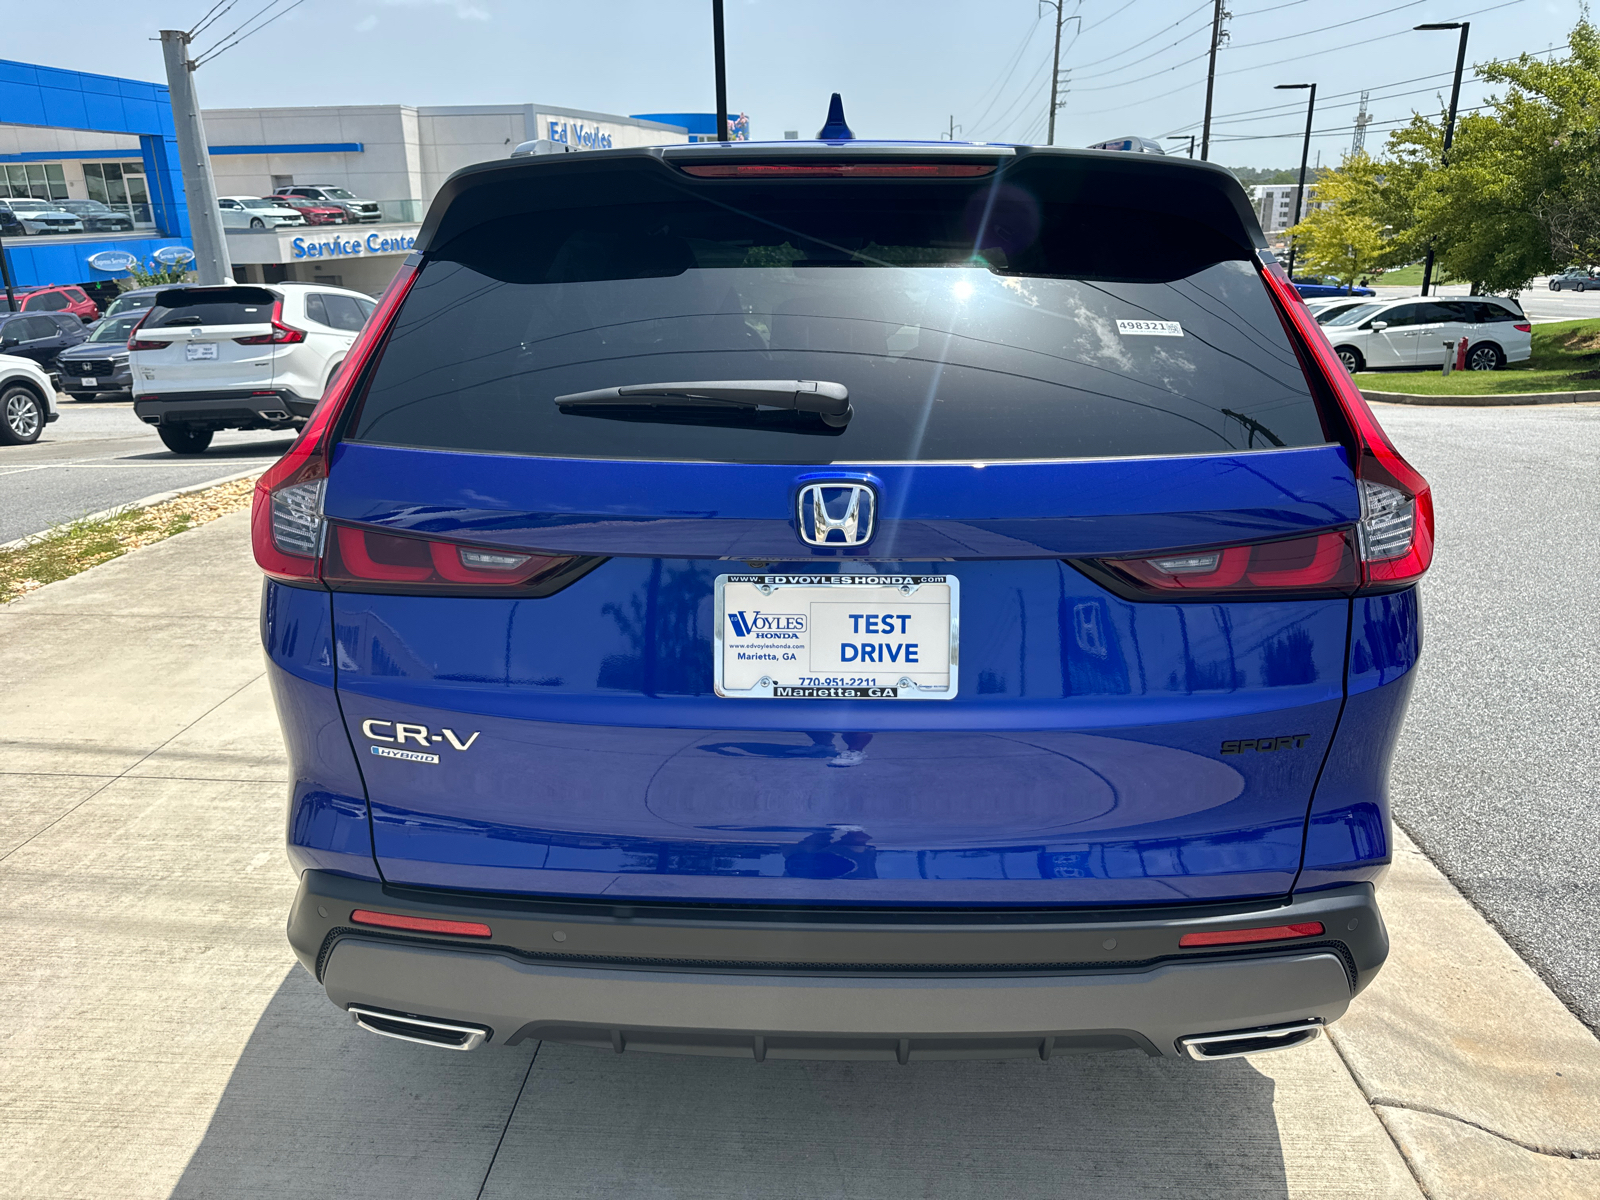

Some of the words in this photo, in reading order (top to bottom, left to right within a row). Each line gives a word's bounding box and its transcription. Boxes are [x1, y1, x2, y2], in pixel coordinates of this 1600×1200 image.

[550, 121, 568, 143] Ed
[573, 123, 612, 149] Voyles
[293, 235, 362, 258] Service
[366, 233, 415, 252] Cente
[1119, 321, 1167, 331] 498321
[737, 611, 804, 635] VOYLES
[849, 614, 911, 634] TEST
[737, 652, 779, 661] Marietta,
[782, 653, 797, 661] GA
[840, 643, 919, 663] DRIVE
[798, 677, 876, 686] 770-951-2211
[777, 688, 861, 697] Marietta,
[868, 688, 894, 697] GA
[362, 719, 480, 750] CR-V
[1220, 734, 1311, 755] SPORT
[380, 748, 435, 762] HYBRID
